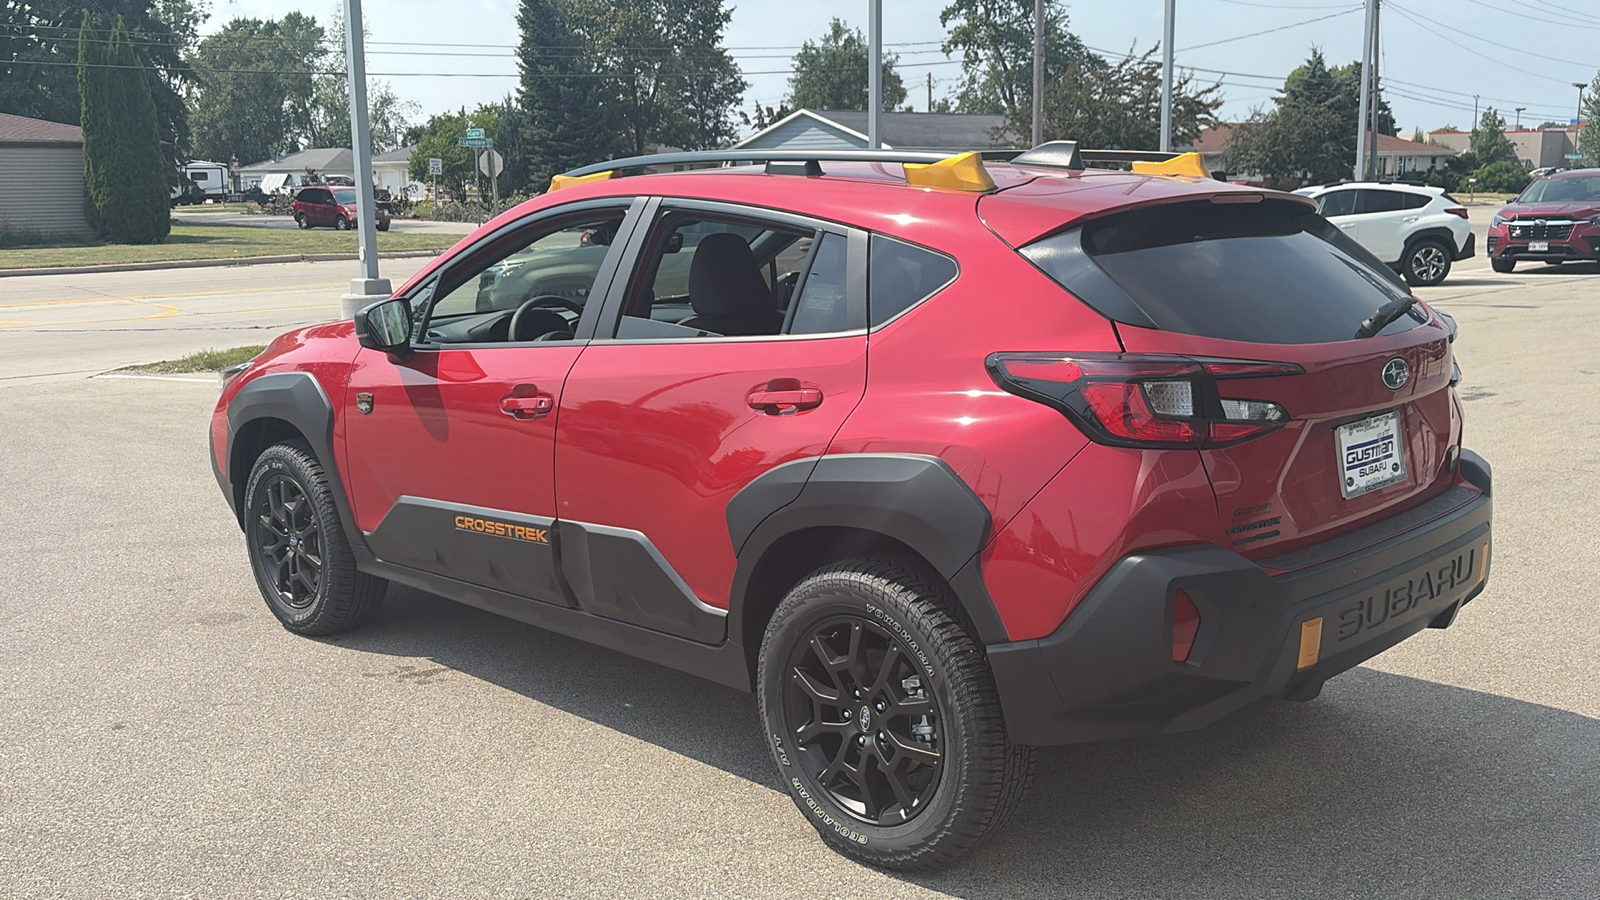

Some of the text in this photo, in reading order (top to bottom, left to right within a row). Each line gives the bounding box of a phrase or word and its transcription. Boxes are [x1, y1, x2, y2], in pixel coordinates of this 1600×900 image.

[1359, 461, 1387, 478] SUBARU
[454, 515, 549, 543] CROSSTREK
[1338, 548, 1475, 642] SUBARU
[865, 603, 936, 677] YOKOHAMA
[773, 734, 868, 845] GEOLANDAR A/T
